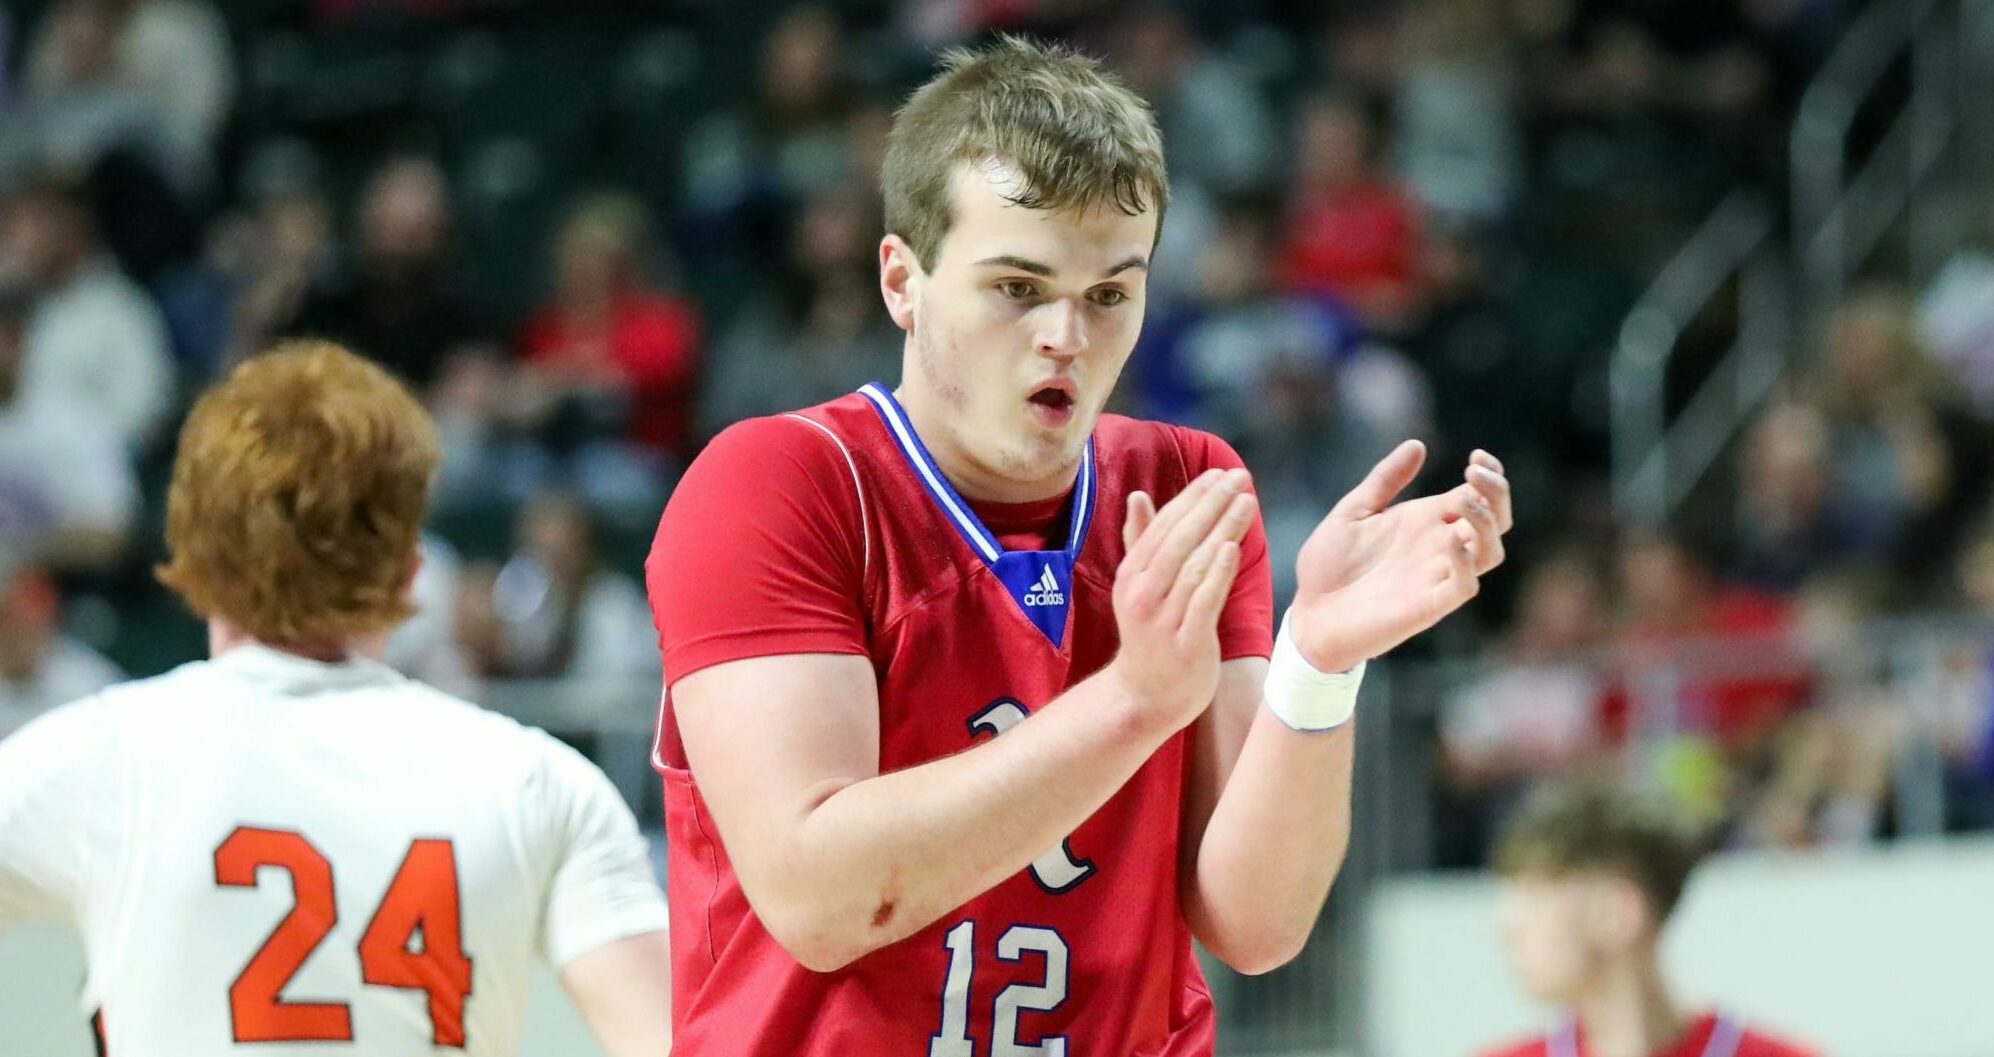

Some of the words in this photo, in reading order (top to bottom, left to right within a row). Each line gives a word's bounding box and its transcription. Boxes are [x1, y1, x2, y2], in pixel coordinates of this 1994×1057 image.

[1024, 590, 1064, 606] adidas
[213, 825, 473, 1048] 24
[929, 919, 1072, 1057] 12
